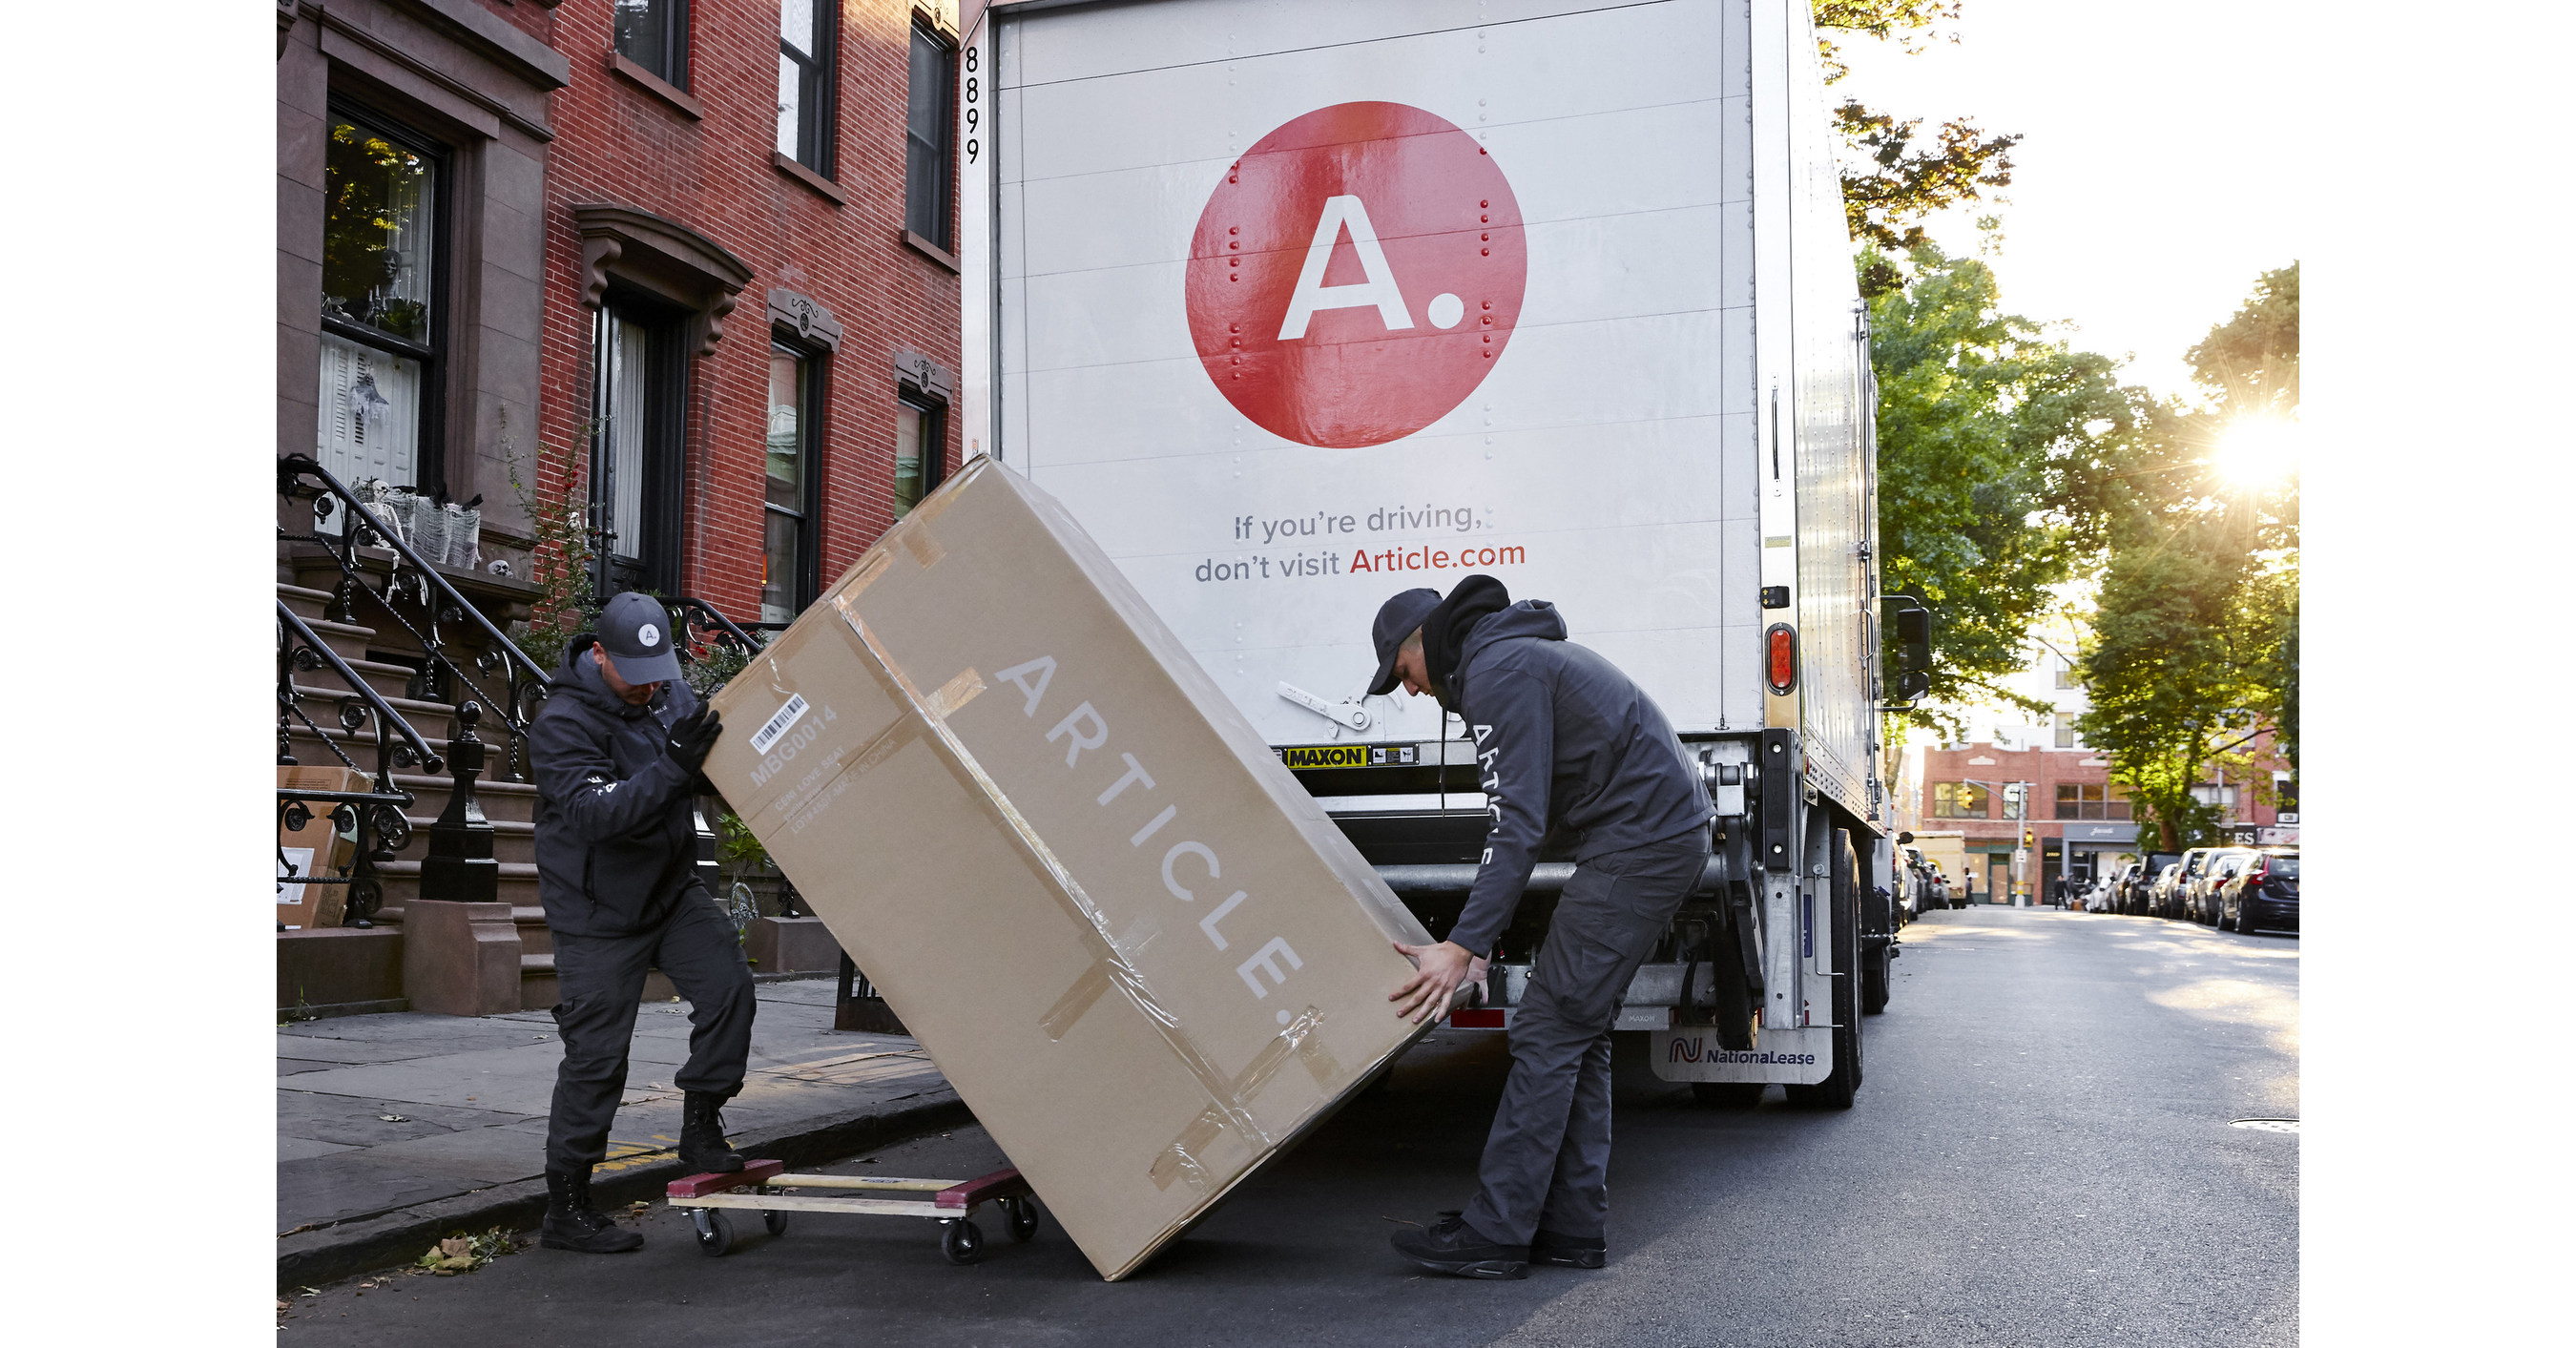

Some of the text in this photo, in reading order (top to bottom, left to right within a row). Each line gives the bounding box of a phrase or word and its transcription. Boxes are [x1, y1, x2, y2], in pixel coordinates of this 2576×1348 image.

[1235, 503, 1483, 545] If you're driving,
[1195, 545, 1526, 583] don't visit Article.com
[749, 704, 838, 788] MBG0014
[1289, 747, 1362, 768] MAXON
[796, 766, 821, 793] LOVE
[821, 744, 846, 769] SEAT
[1472, 724, 1503, 864] ARTICE
[1628, 1014, 1656, 1023] MAXON
[1707, 1049, 1816, 1066] NationaLease
